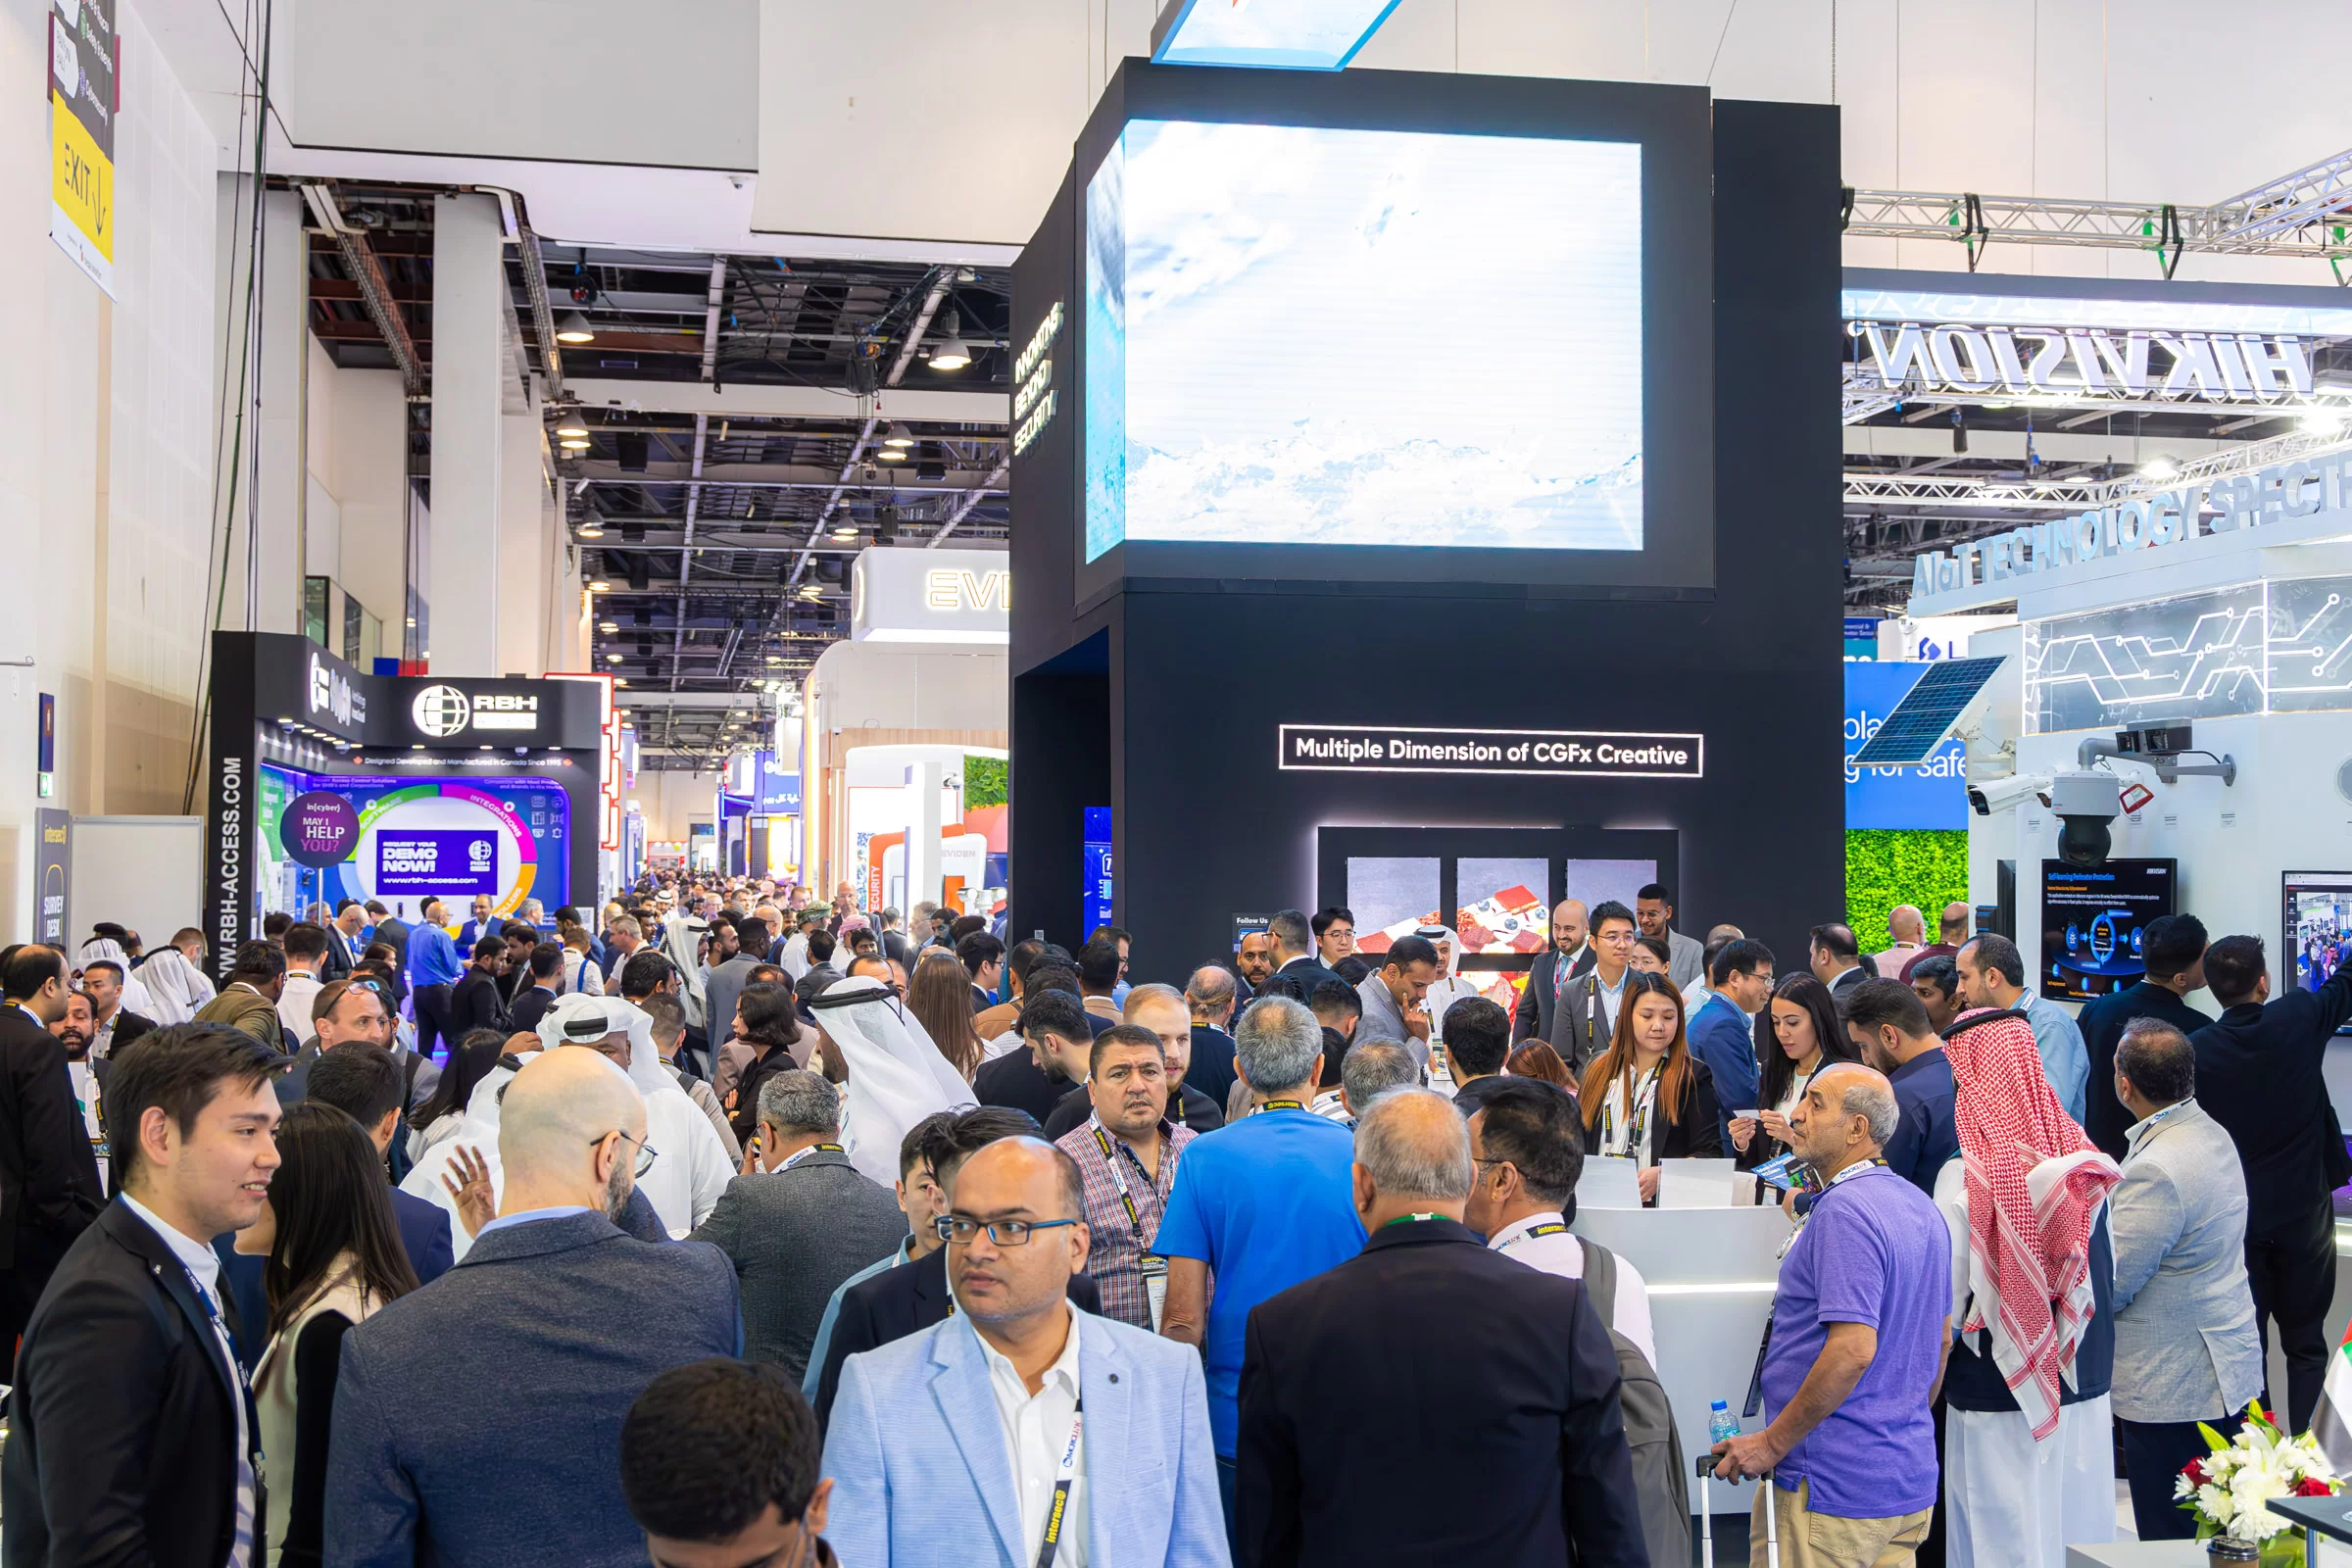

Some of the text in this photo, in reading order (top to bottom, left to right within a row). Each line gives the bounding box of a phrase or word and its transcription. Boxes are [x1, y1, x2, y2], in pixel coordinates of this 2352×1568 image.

[65, 142, 90, 206] EXIT
[1015, 360, 1052, 420] BEYOND
[1014, 390, 1058, 456] SECURITY
[1976, 486, 2204, 584] TECHNOLOGY
[472, 695, 537, 710] RBH
[1297, 738, 1688, 764] Multiple Dimension of CGFx Creative
[396, 758, 432, 766] Developed
[470, 795, 522, 838] INTEGRATIONS
[306, 826, 345, 839] HELP
[301, 839, 339, 853] YOU?
[382, 848, 438, 859] DEMO
[382, 860, 436, 872] NOW!
[871, 865, 880, 912] ECURITY
[43, 896, 64, 915] SURVEY
[46, 919, 60, 938] DESK
[1271, 1101, 1299, 1109] intersec
[1045, 1495, 1066, 1544] intersec
